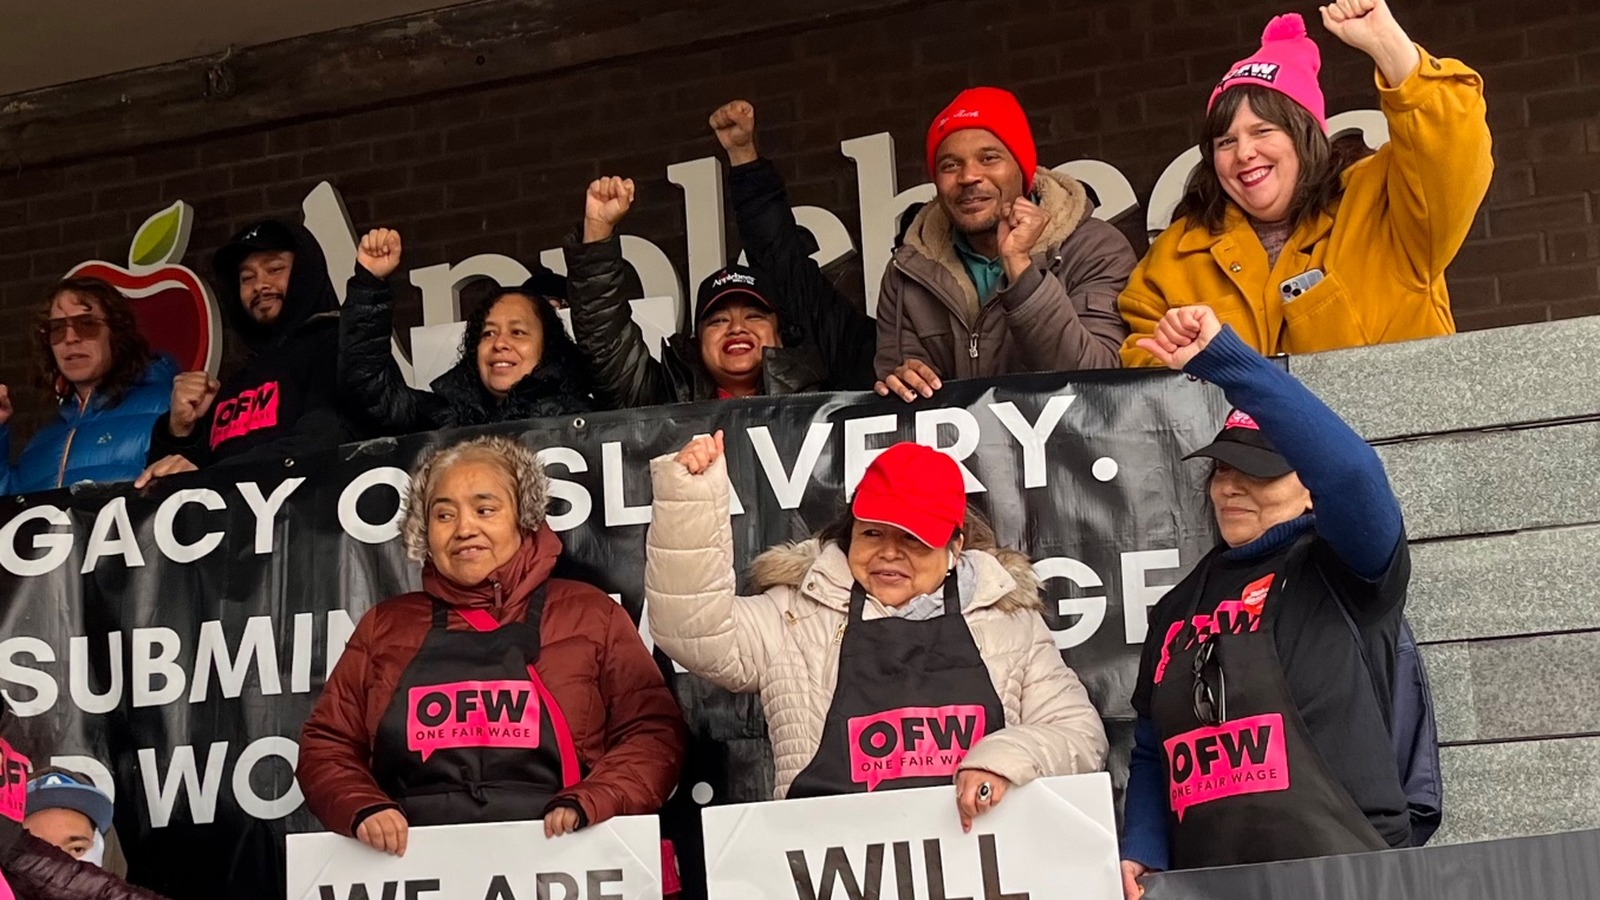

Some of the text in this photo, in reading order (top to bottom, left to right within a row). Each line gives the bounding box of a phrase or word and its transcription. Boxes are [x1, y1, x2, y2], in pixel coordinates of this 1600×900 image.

[215, 387, 276, 429] OFW
[0, 476, 307, 576] GACY
[337, 466, 412, 544] O
[416, 689, 531, 728] OFW
[417, 728, 530, 740] ONE FAIR WAGE
[859, 715, 976, 758] OFW
[1173, 725, 1271, 784] OFW
[862, 755, 962, 771] ONE FAIR WA
[1172, 770, 1277, 799] ONE FAIR WAGE
[785, 833, 1031, 900] WILL
